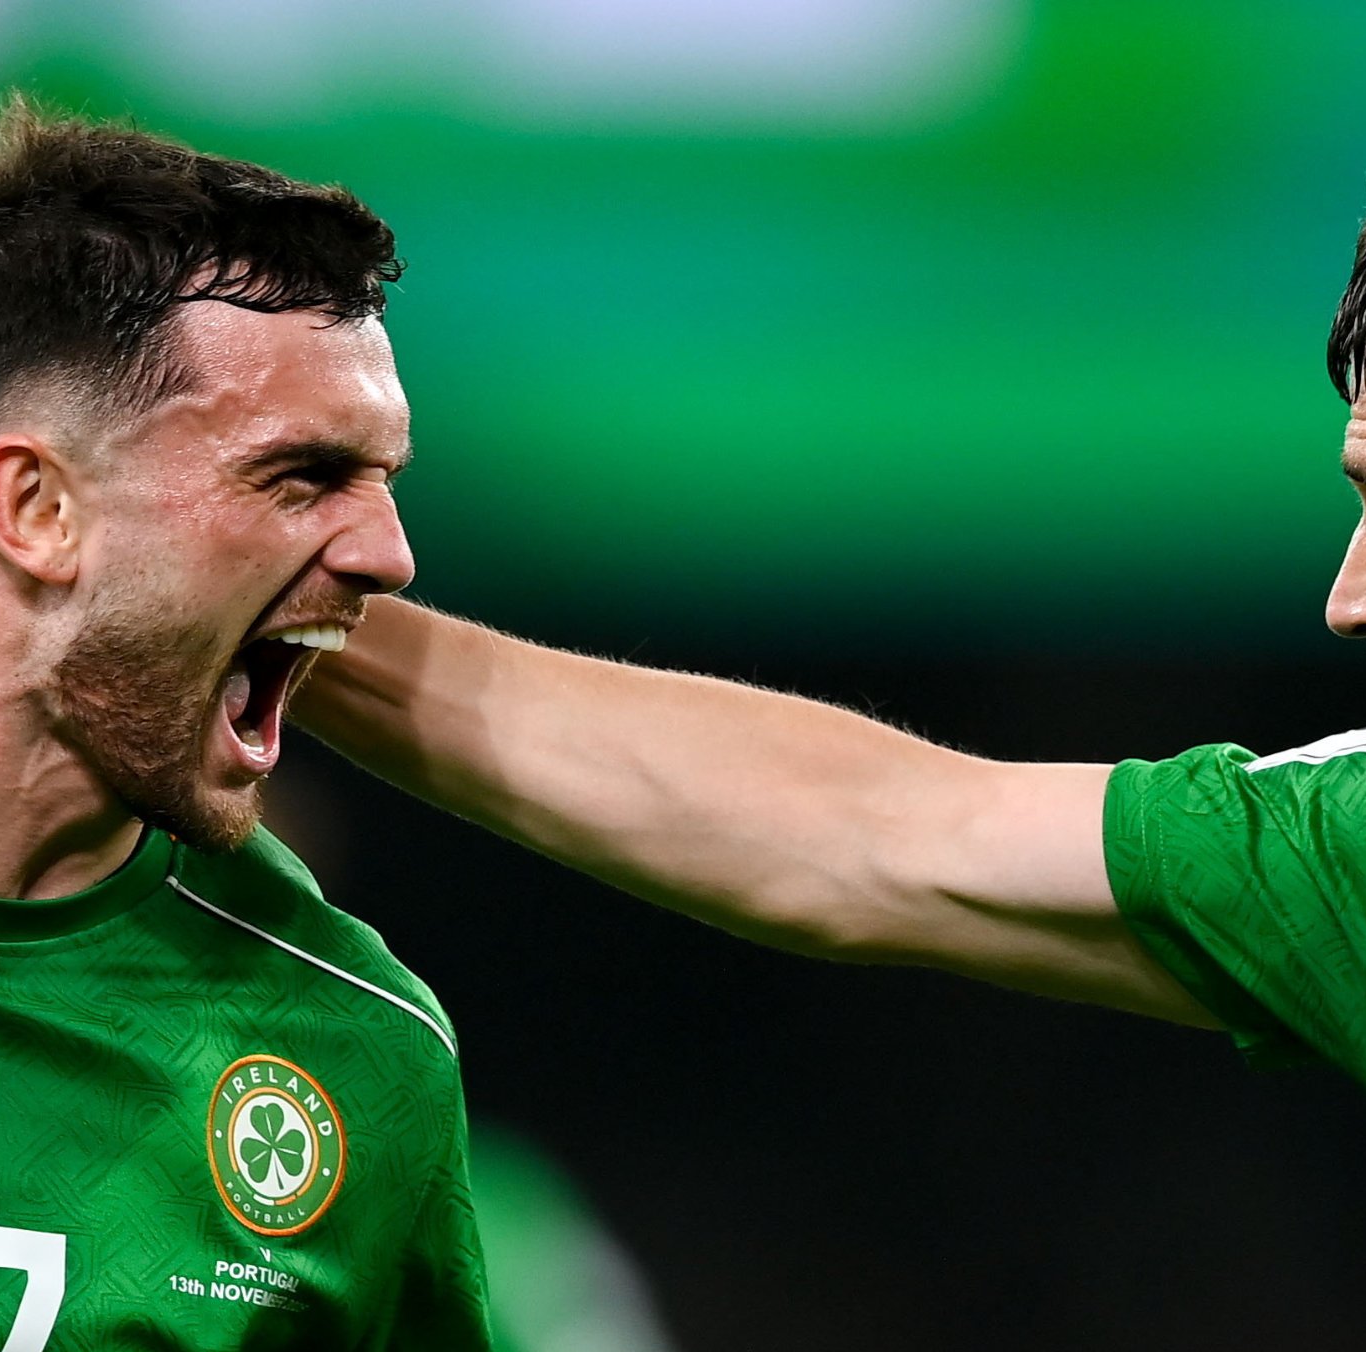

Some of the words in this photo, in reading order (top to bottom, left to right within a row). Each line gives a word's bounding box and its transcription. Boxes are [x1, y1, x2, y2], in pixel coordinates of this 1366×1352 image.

[222, 1066, 333, 1136] IRELAND
[226, 1181, 305, 1224] FOOTBALL
[169, 1275, 205, 1297] 13th
[215, 1261, 299, 1293] PORTUGAL
